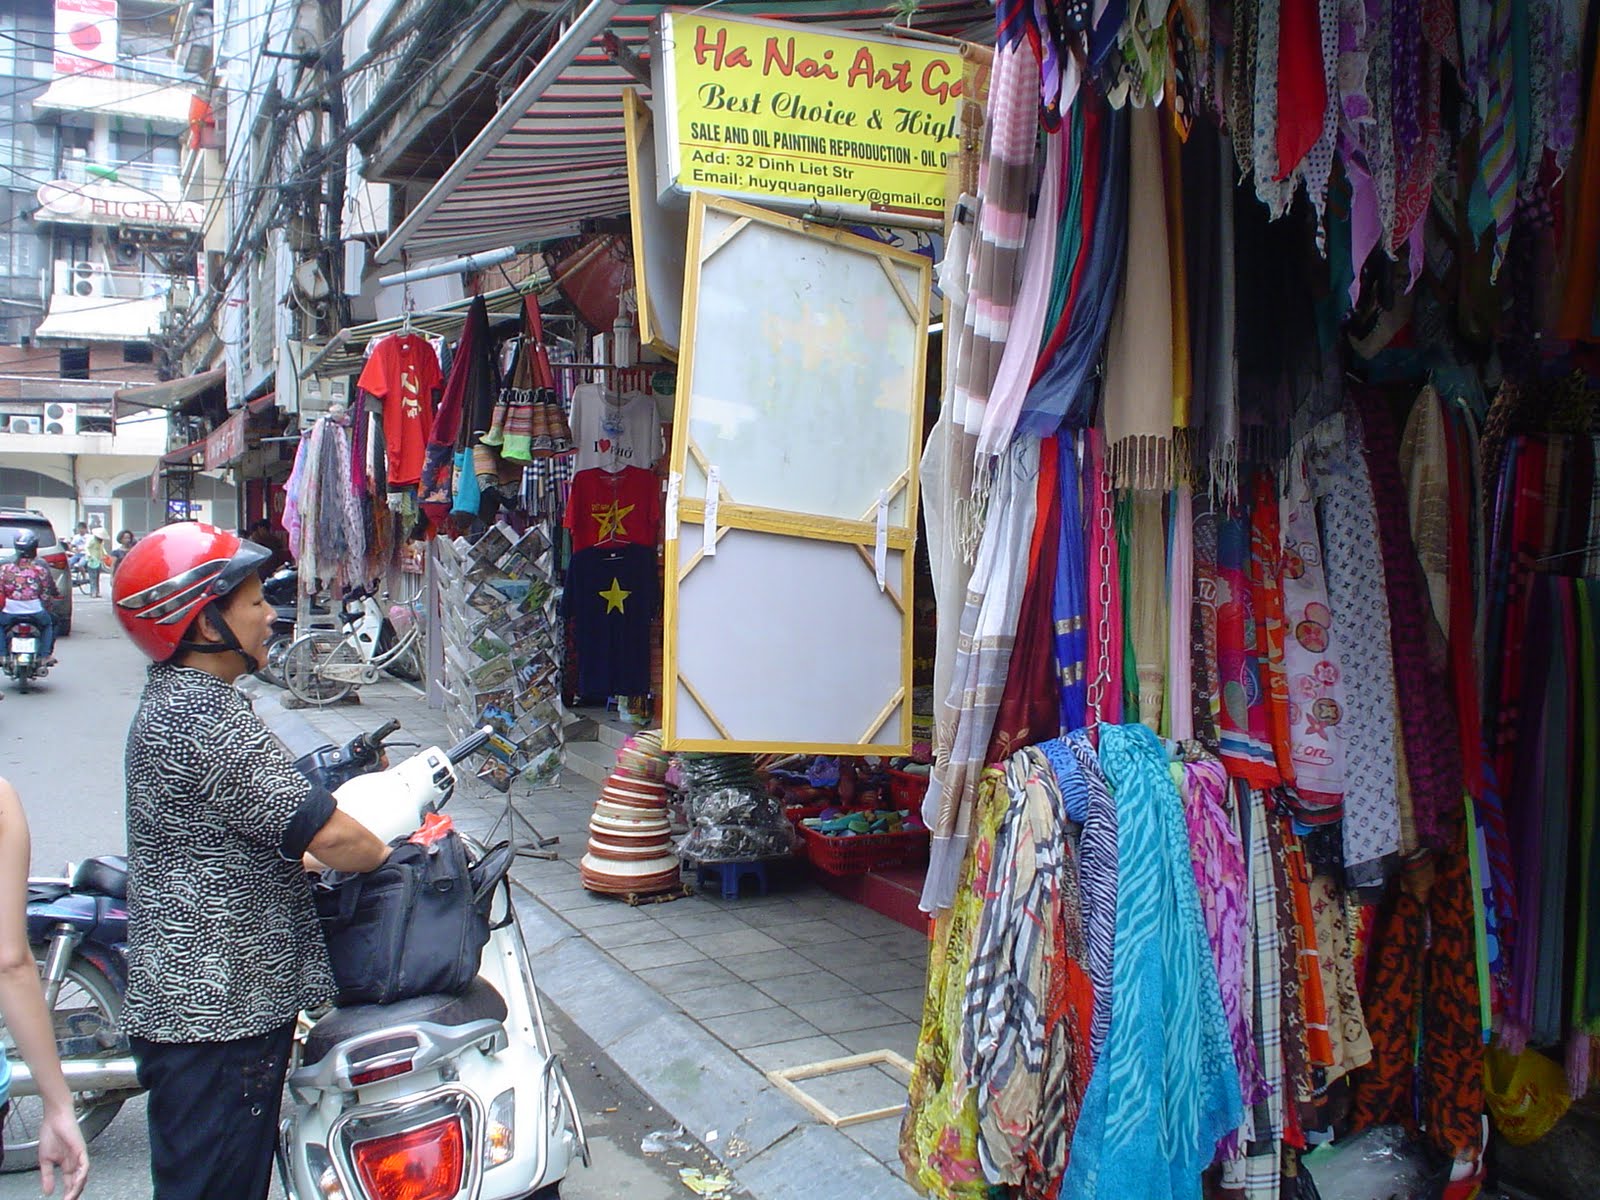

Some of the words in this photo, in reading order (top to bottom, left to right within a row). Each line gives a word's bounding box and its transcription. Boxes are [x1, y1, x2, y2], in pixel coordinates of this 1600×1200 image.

[694, 25, 752, 71] Ha
[763, 36, 838, 80] Noi
[848, 46, 912, 93] Art
[698, 83, 762, 114] Best
[771, 92, 858, 127] Choice
[867, 109, 882, 130] &
[691, 122, 720, 141] SALE
[725, 126, 749, 145] AND
[753, 129, 770, 148] OIL
[774, 132, 826, 155] PAINTING
[830, 139, 911, 164] REPRODUCTION
[921, 150, 938, 168] OIL
[692, 150, 730, 165] Add:
[736, 154, 754, 168] 32
[759, 157, 795, 172] Dinh
[800, 162, 828, 177] Liet
[833, 166, 854, 179] Str
[693, 169, 743, 185] Email:
[749, 175, 945, 207] huyquangallery@gmail.co
[92, 199, 204, 224] HIGHLA
